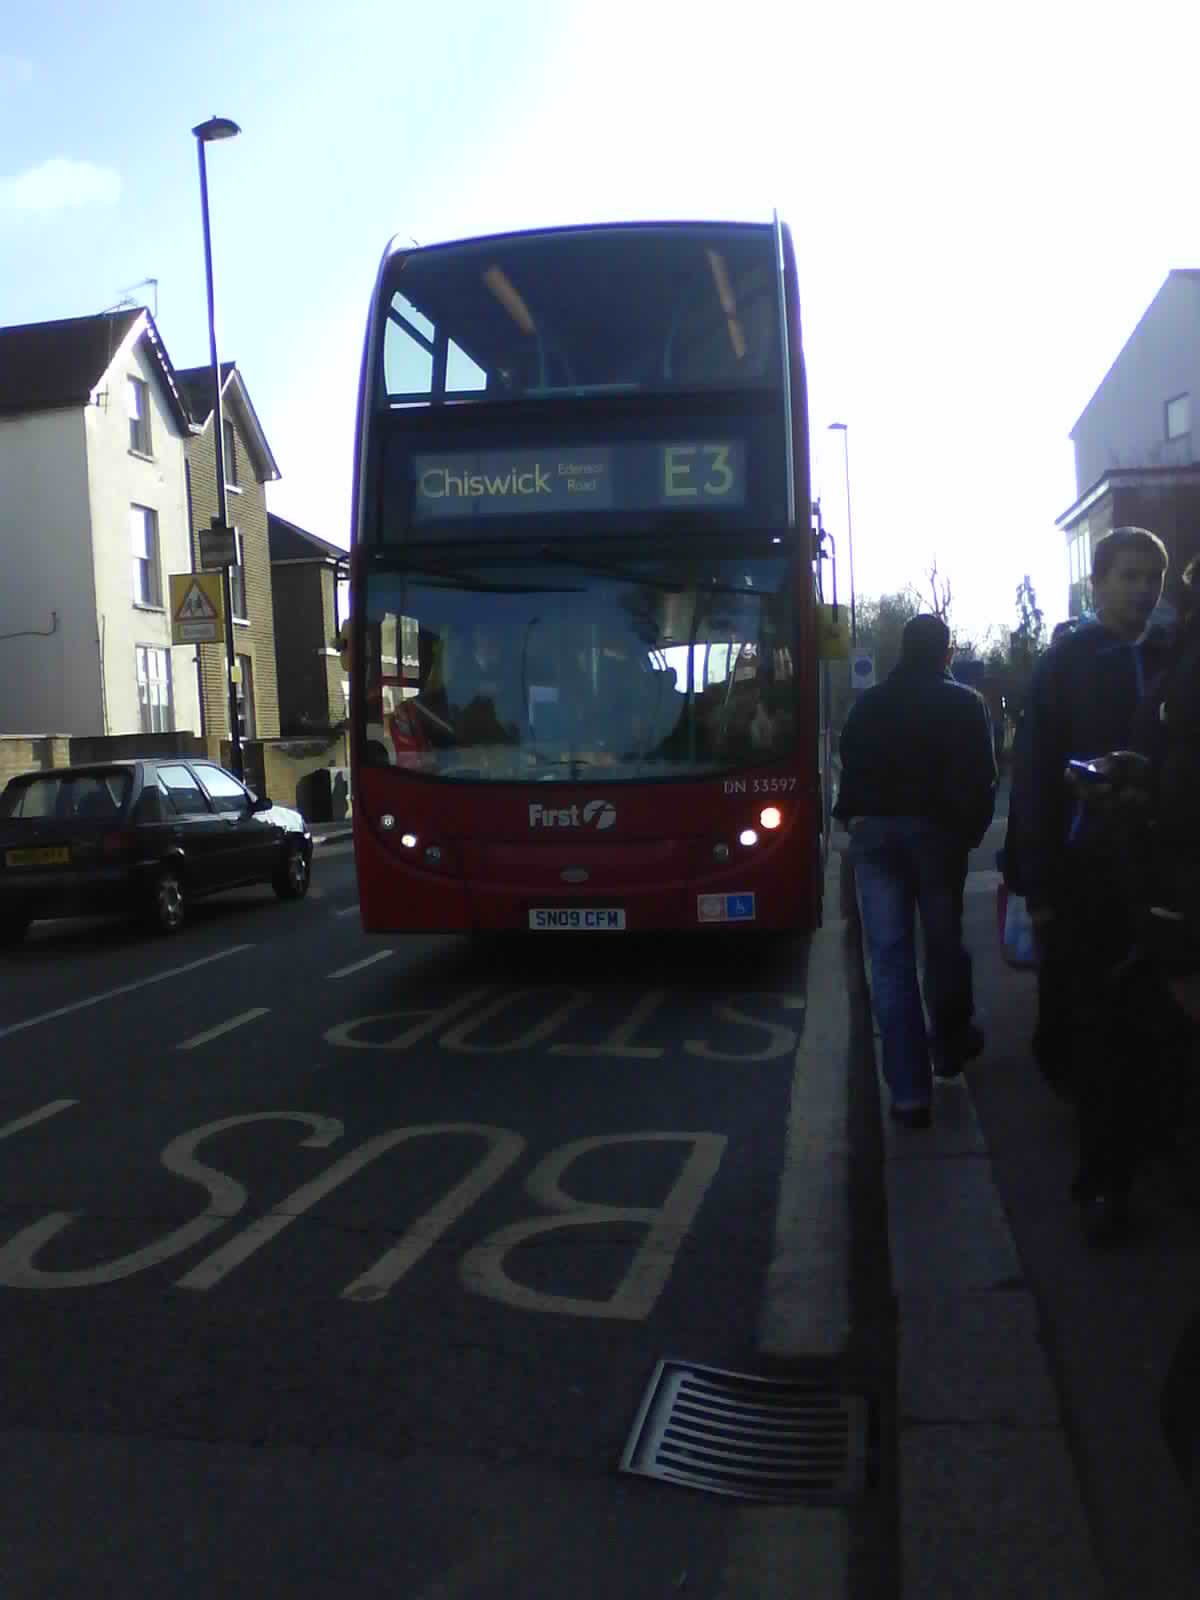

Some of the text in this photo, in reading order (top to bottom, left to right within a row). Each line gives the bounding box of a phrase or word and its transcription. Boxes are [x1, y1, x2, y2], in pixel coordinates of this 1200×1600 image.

[420, 464, 552, 498] Chiswick
[723, 780, 747, 793] DN
[528, 803, 580, 827] First
[536, 910, 618, 925] SN09 CFM
[323, 988, 805, 1062] STOP
[0, 1110, 729, 1321] BUS
